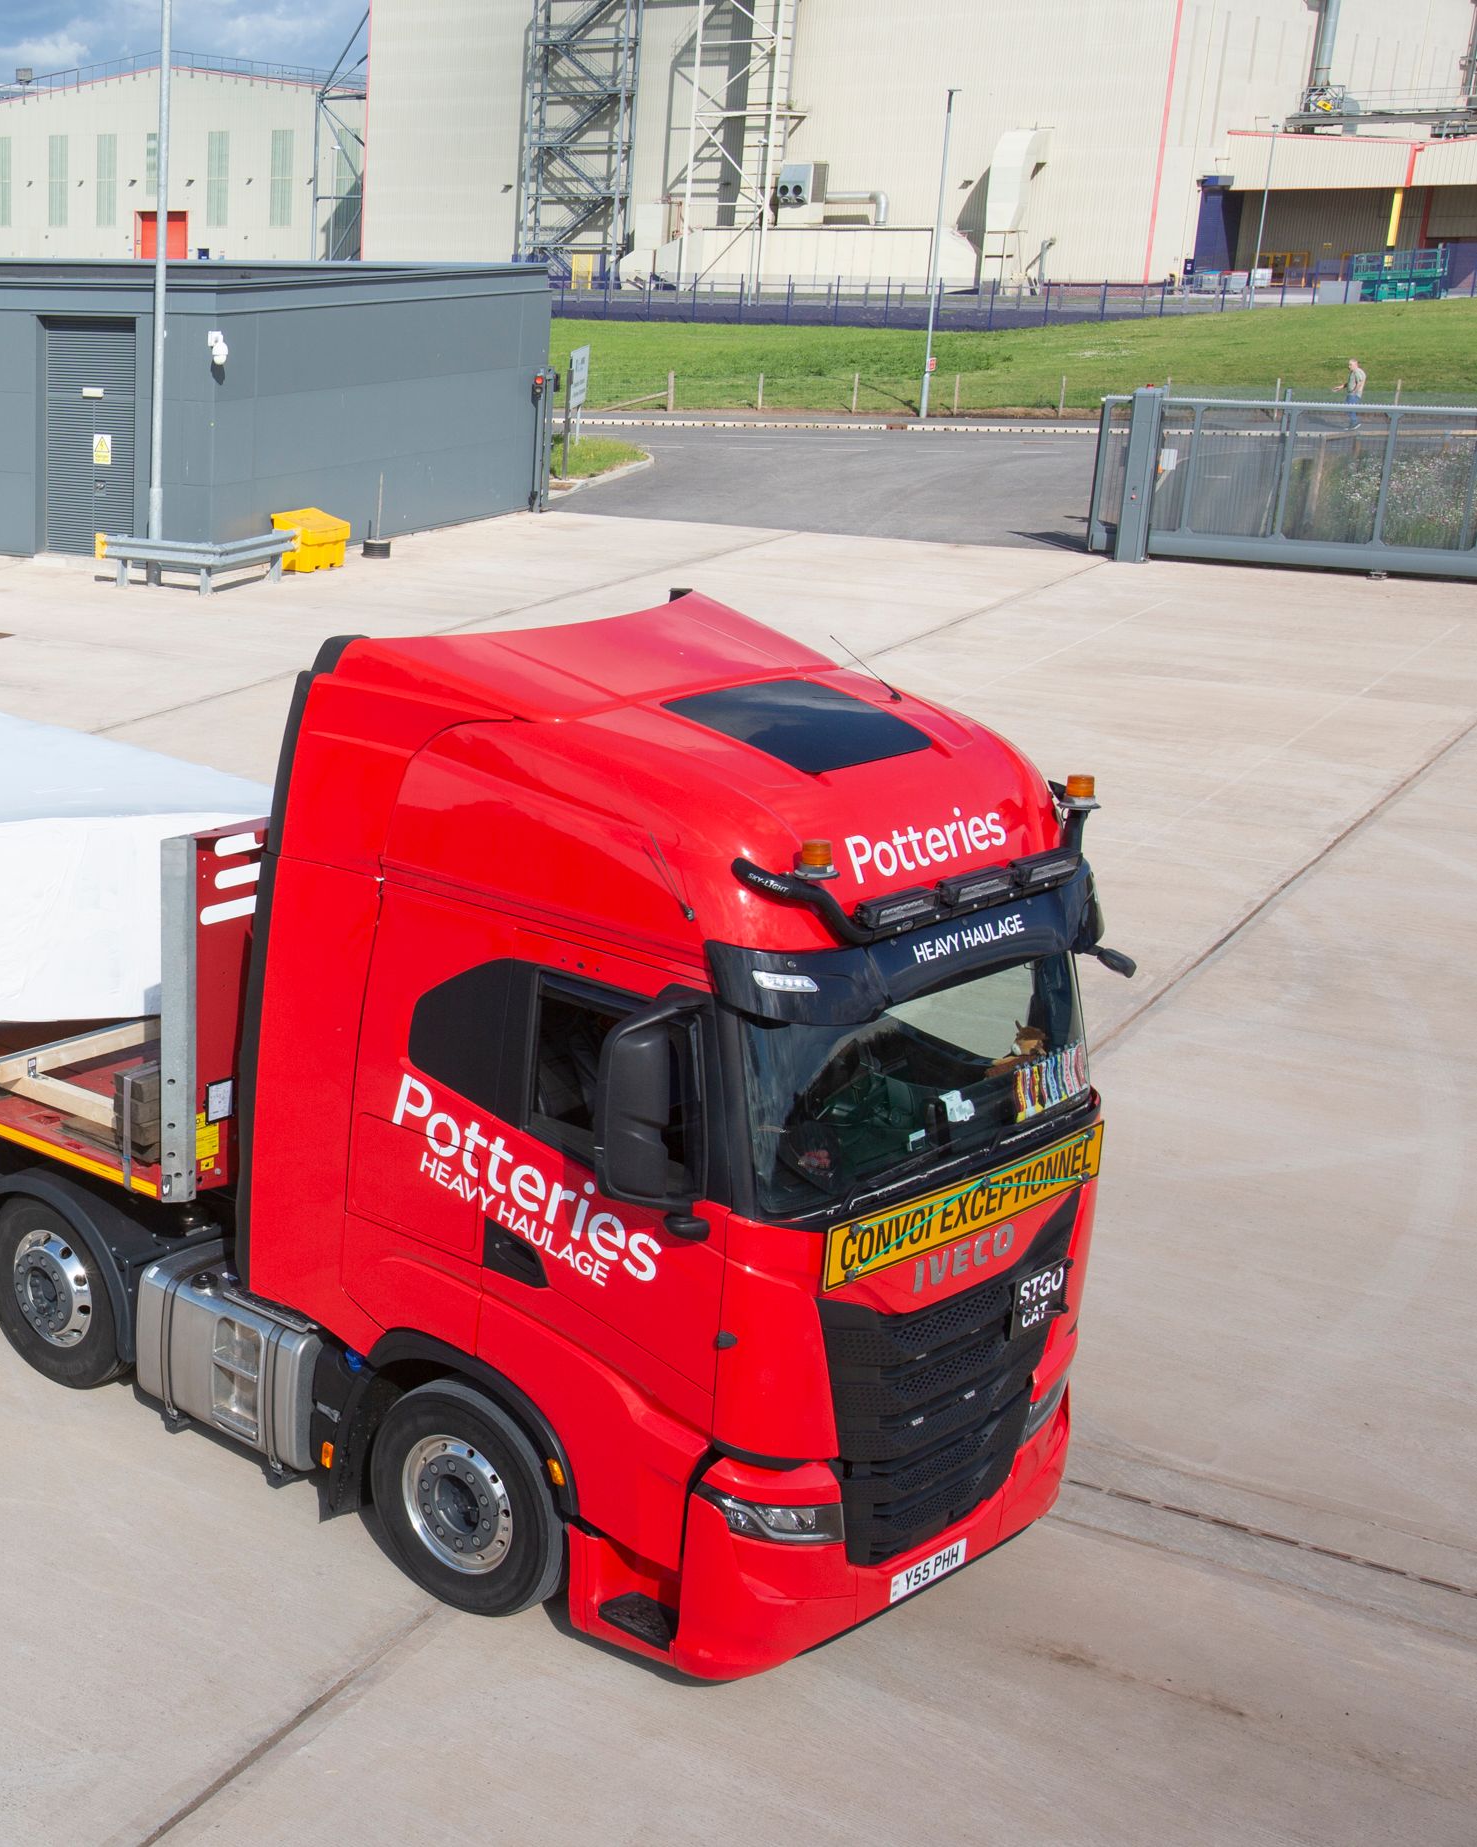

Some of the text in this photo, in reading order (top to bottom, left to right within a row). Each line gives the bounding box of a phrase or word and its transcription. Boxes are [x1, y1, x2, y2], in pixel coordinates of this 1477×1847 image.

[844, 807, 1007, 885] Potteries
[747, 872, 789, 894] SKY-LIGHT
[913, 913, 1026, 964] HEAVY HAULAGE
[391, 1073, 662, 1282] Potteries
[840, 1136, 1092, 1271] CONVOI EXCEPTIONNEL
[419, 1151, 610, 1287] HEAVY HAULAGE
[912, 1223, 1015, 1294] IVECO
[1019, 1265, 1065, 1305] STGO
[1021, 1300, 1049, 1328] CAT
[905, 1544, 960, 1591] Y55 PHH
